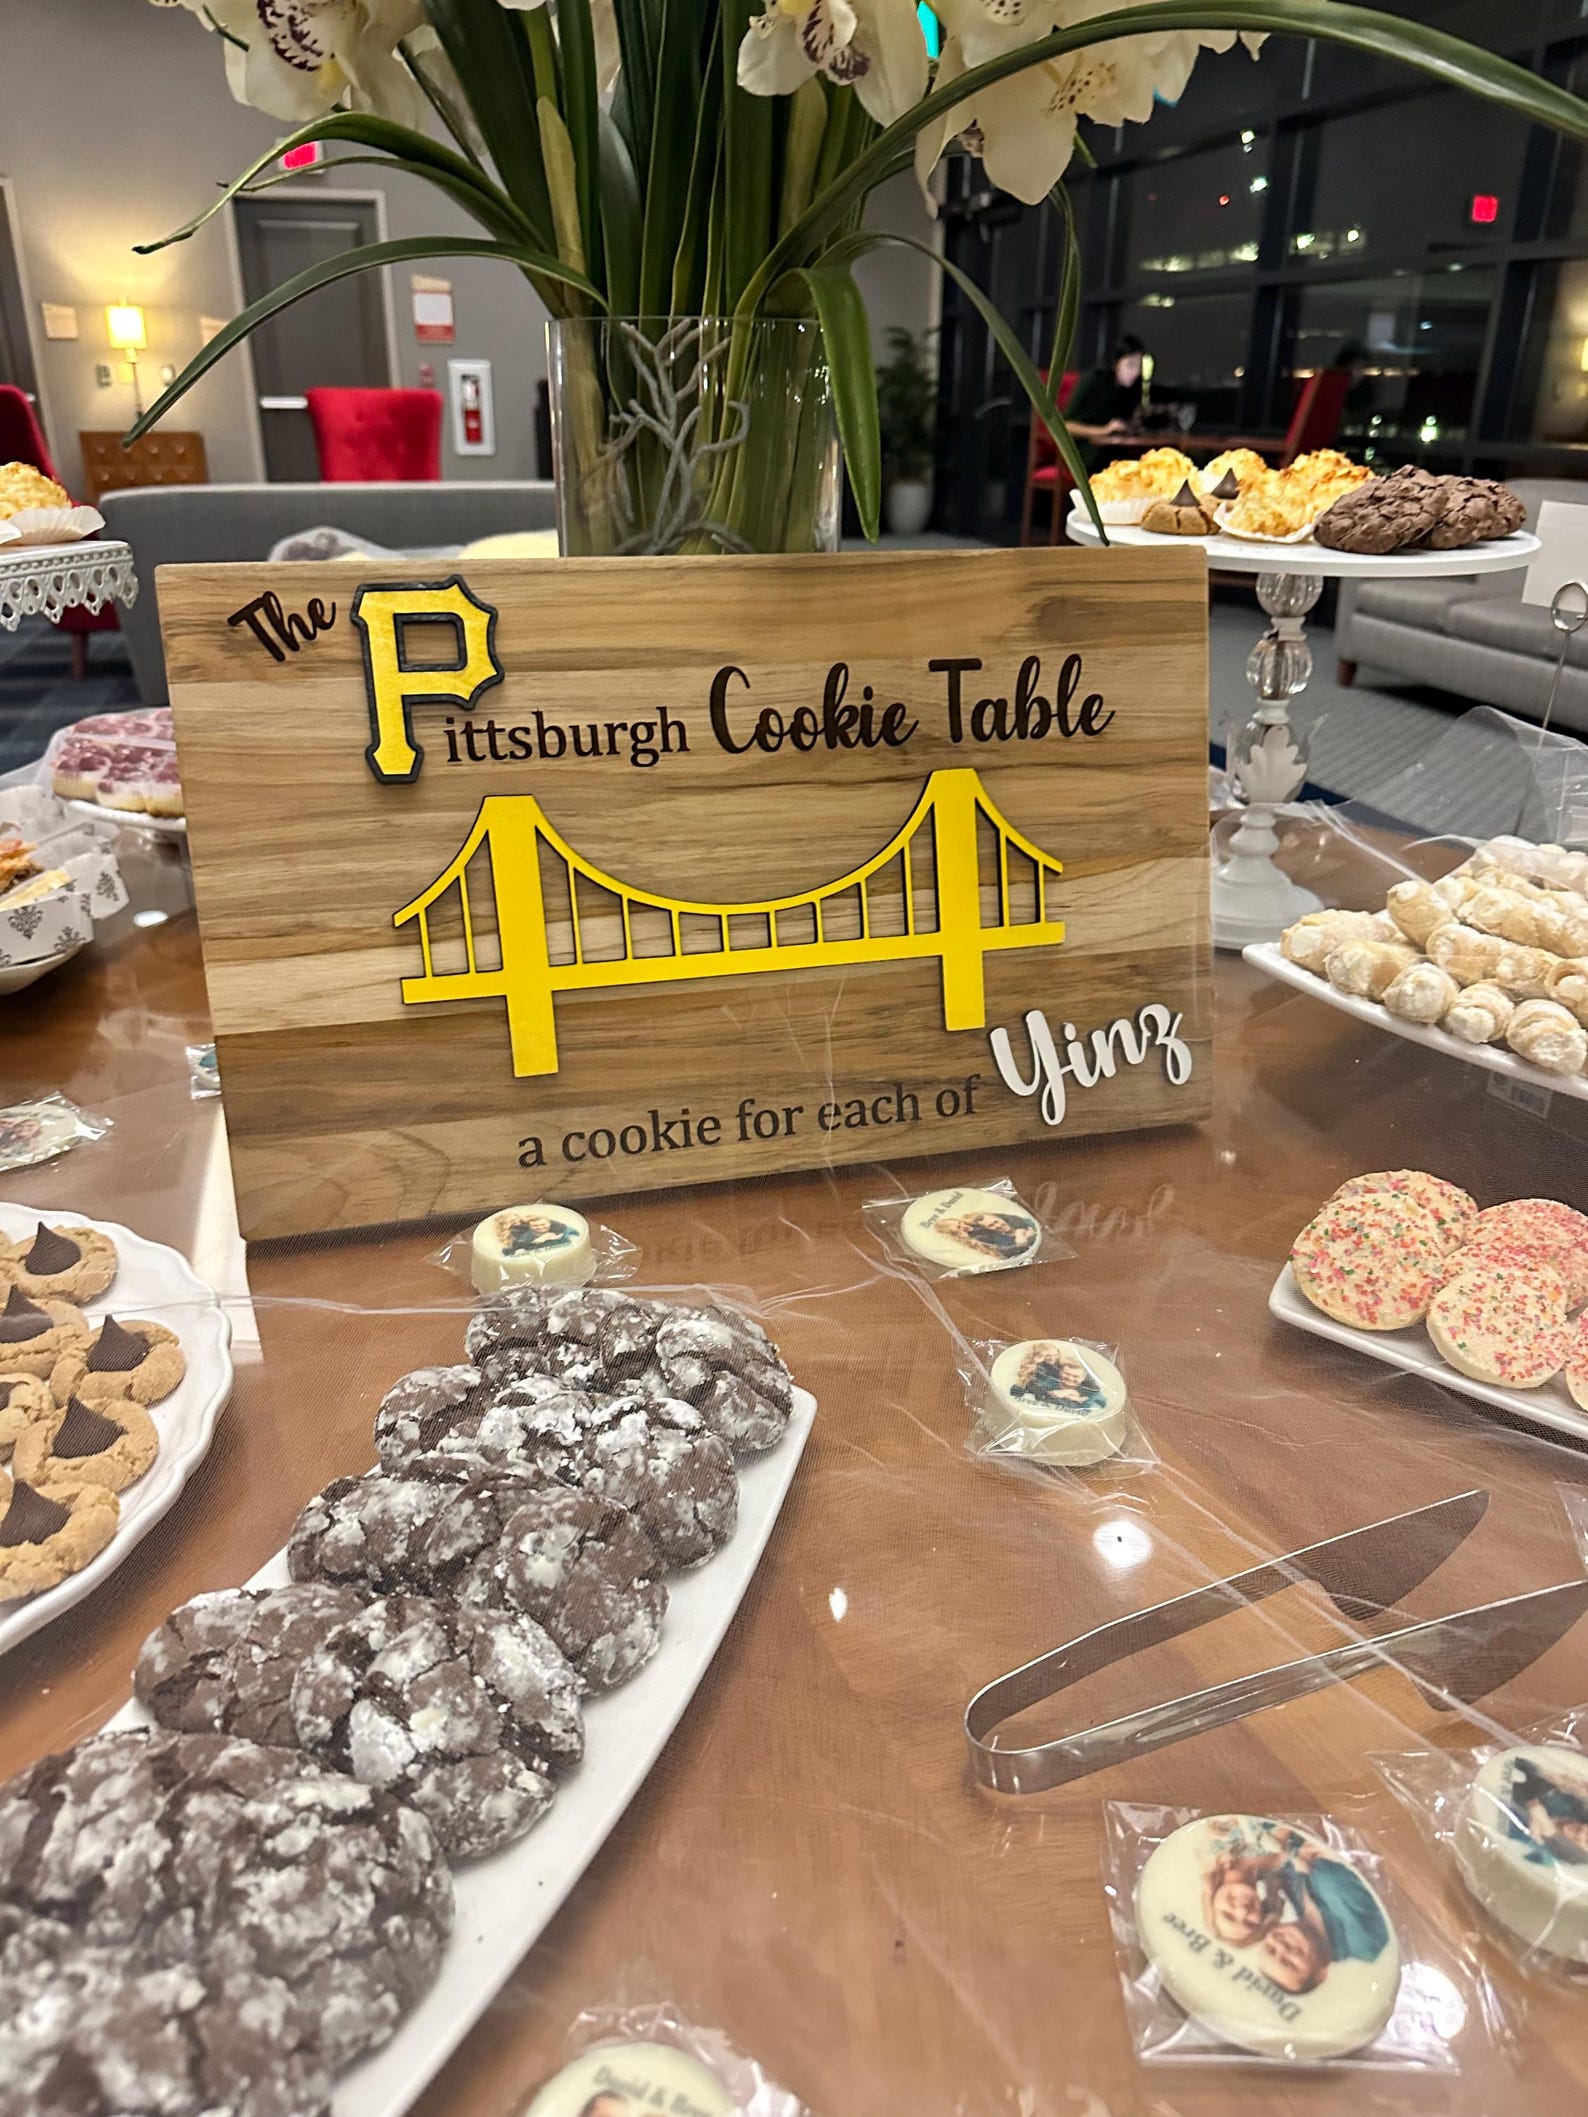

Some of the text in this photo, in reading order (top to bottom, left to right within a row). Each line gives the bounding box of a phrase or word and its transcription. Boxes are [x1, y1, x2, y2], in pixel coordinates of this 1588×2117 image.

[227, 590, 336, 662] The
[709, 662, 919, 755] Cookie
[928, 653, 1116, 744] Table
[517, 1003, 1193, 1169] a cookie for each of Yinz
[1162, 1911, 1303, 2022] David & Bree
